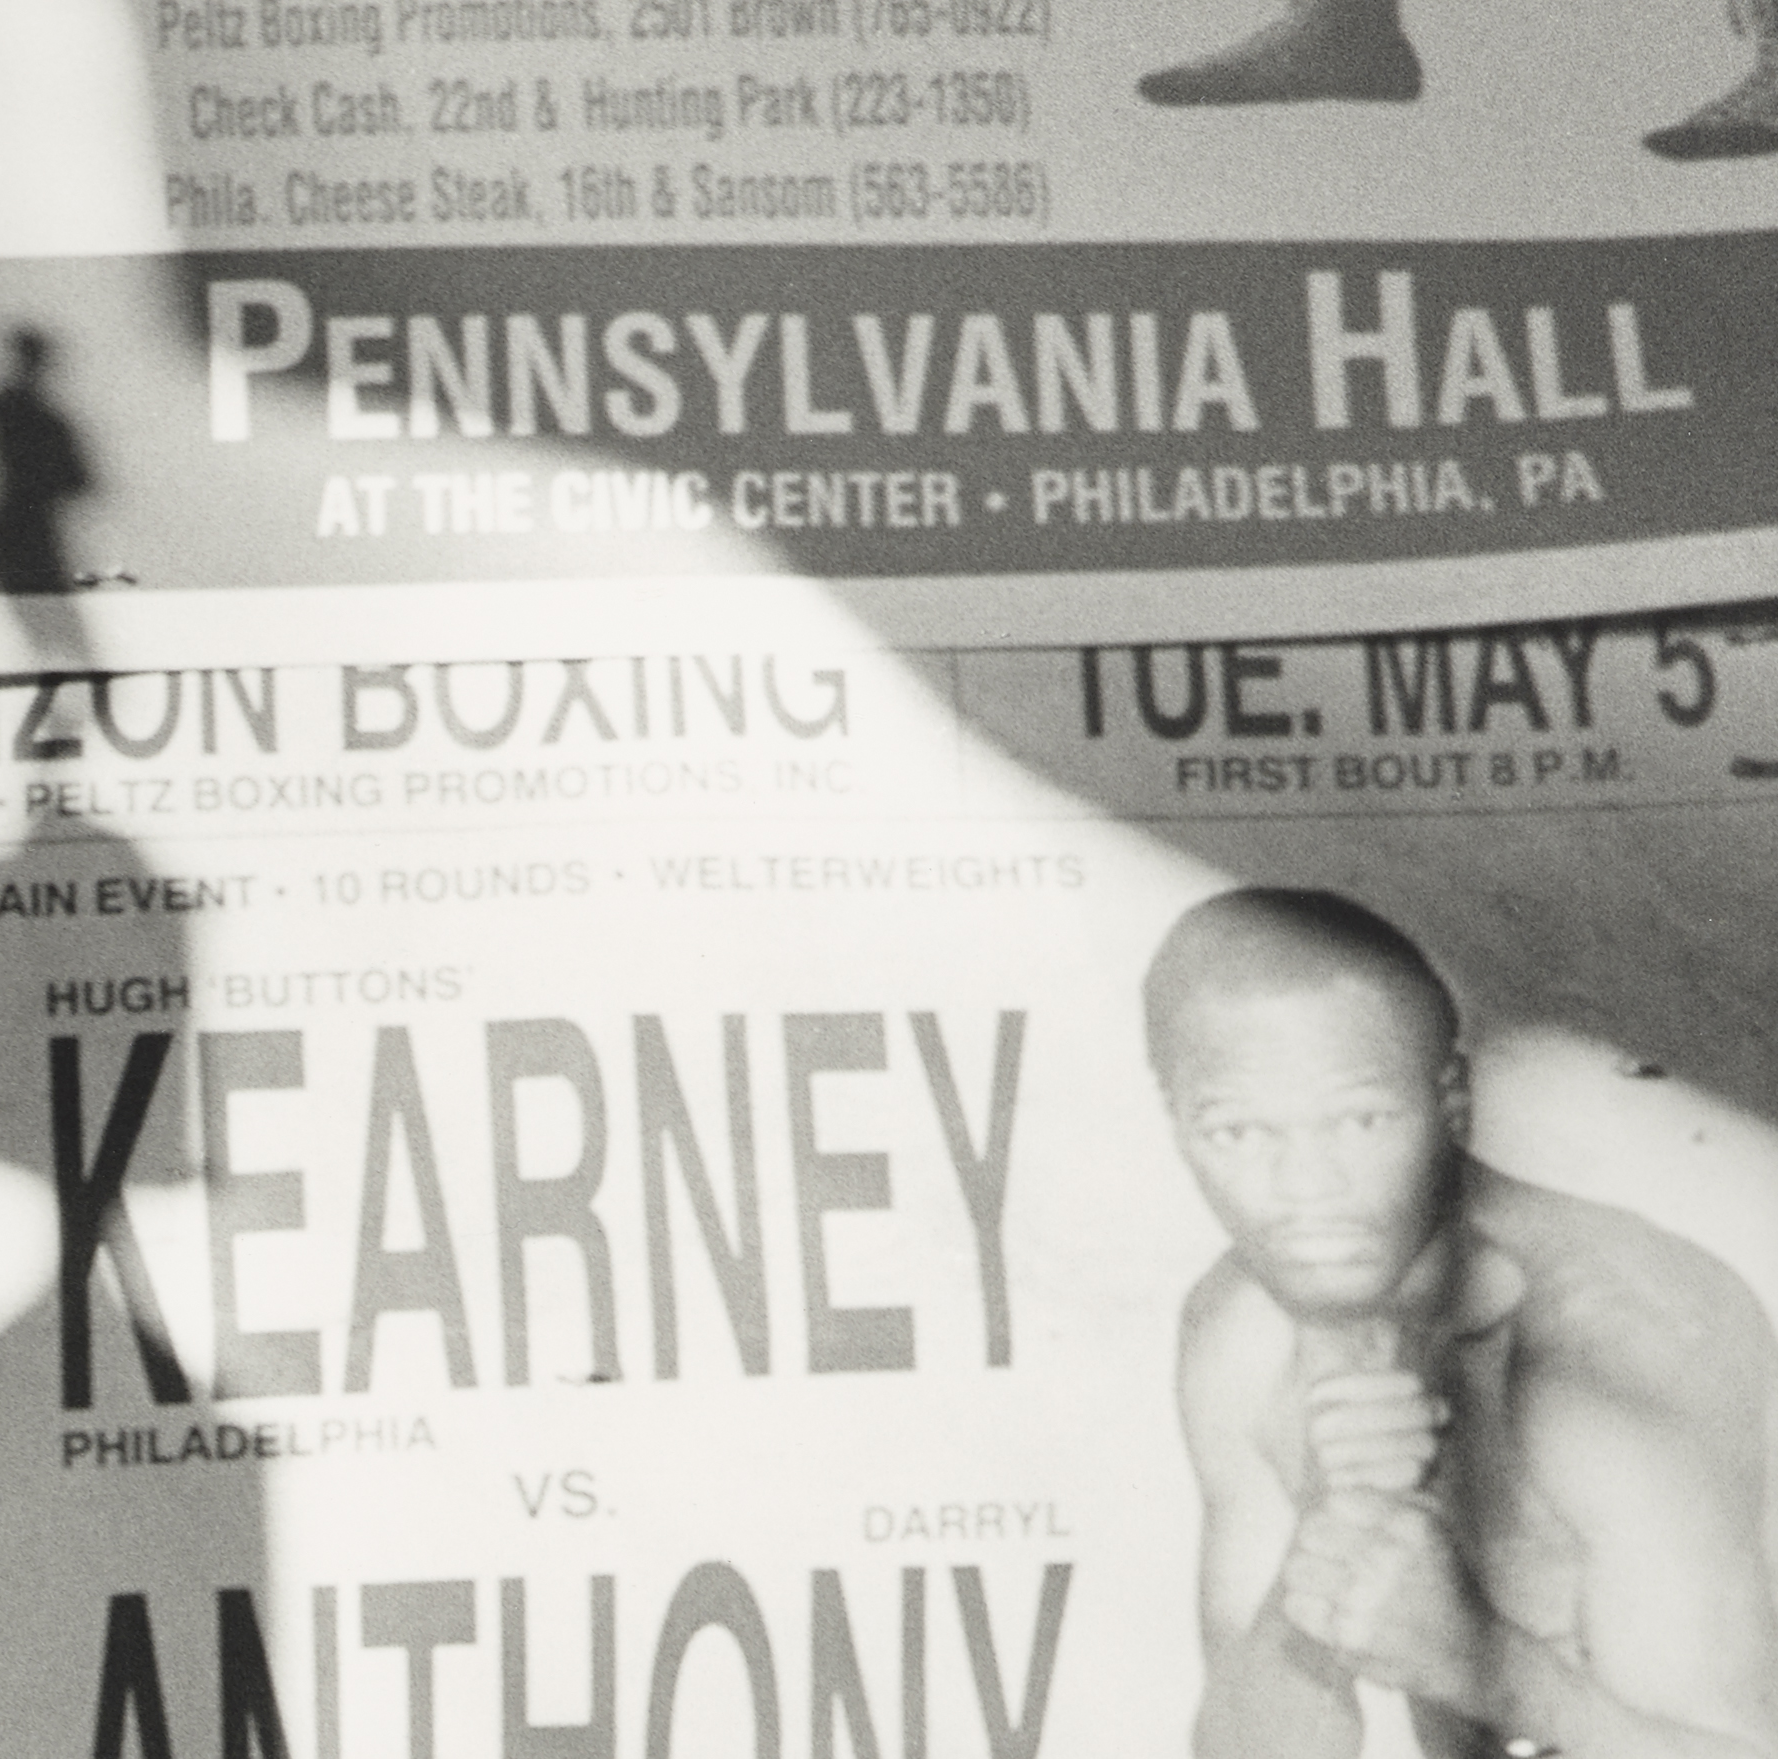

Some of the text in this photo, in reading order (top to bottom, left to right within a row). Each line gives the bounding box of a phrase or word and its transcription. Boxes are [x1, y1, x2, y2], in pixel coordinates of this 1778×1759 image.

[191, 83, 298, 140] Check
[428, 77, 517, 133] 22nd
[535, 77, 557, 132] &
[584, 76, 724, 141] Hunting
[739, 74, 817, 127] Park
[285, 168, 416, 226] Cheese
[561, 163, 635, 220] 16th
[651, 163, 676, 218] &
[691, 162, 835, 220] Sansom
[314, 475, 398, 538] AT
[411, 471, 536, 534] THE
[549, 469, 714, 533] CIVIC
[731, 467, 961, 530] CENTER
[1515, 449, 1605, 508] PA
[340, 654, 855, 753] BOXING
[1363, 628, 1600, 735] MAY
[25, 778, 177, 822] PELTZ
[192, 770, 386, 815] BOXING
[1175, 752, 1325, 794] FIRST
[1334, 748, 1475, 792] BOUT
[1487, 748, 1517, 788] 8
[95, 870, 259, 916] EVENT
[313, 869, 363, 908] 10
[381, 860, 593, 904] ROUNDS
[648, 848, 1089, 894] WELTERWEIGHTS
[47, 974, 193, 1018] HUGH
[49, 1008, 1031, 1412] KEARNEY
[61, 1413, 439, 1470] PHILADELPHIA
[509, 1467, 621, 1522] VS.
[863, 1501, 1071, 1544] DARRYL
